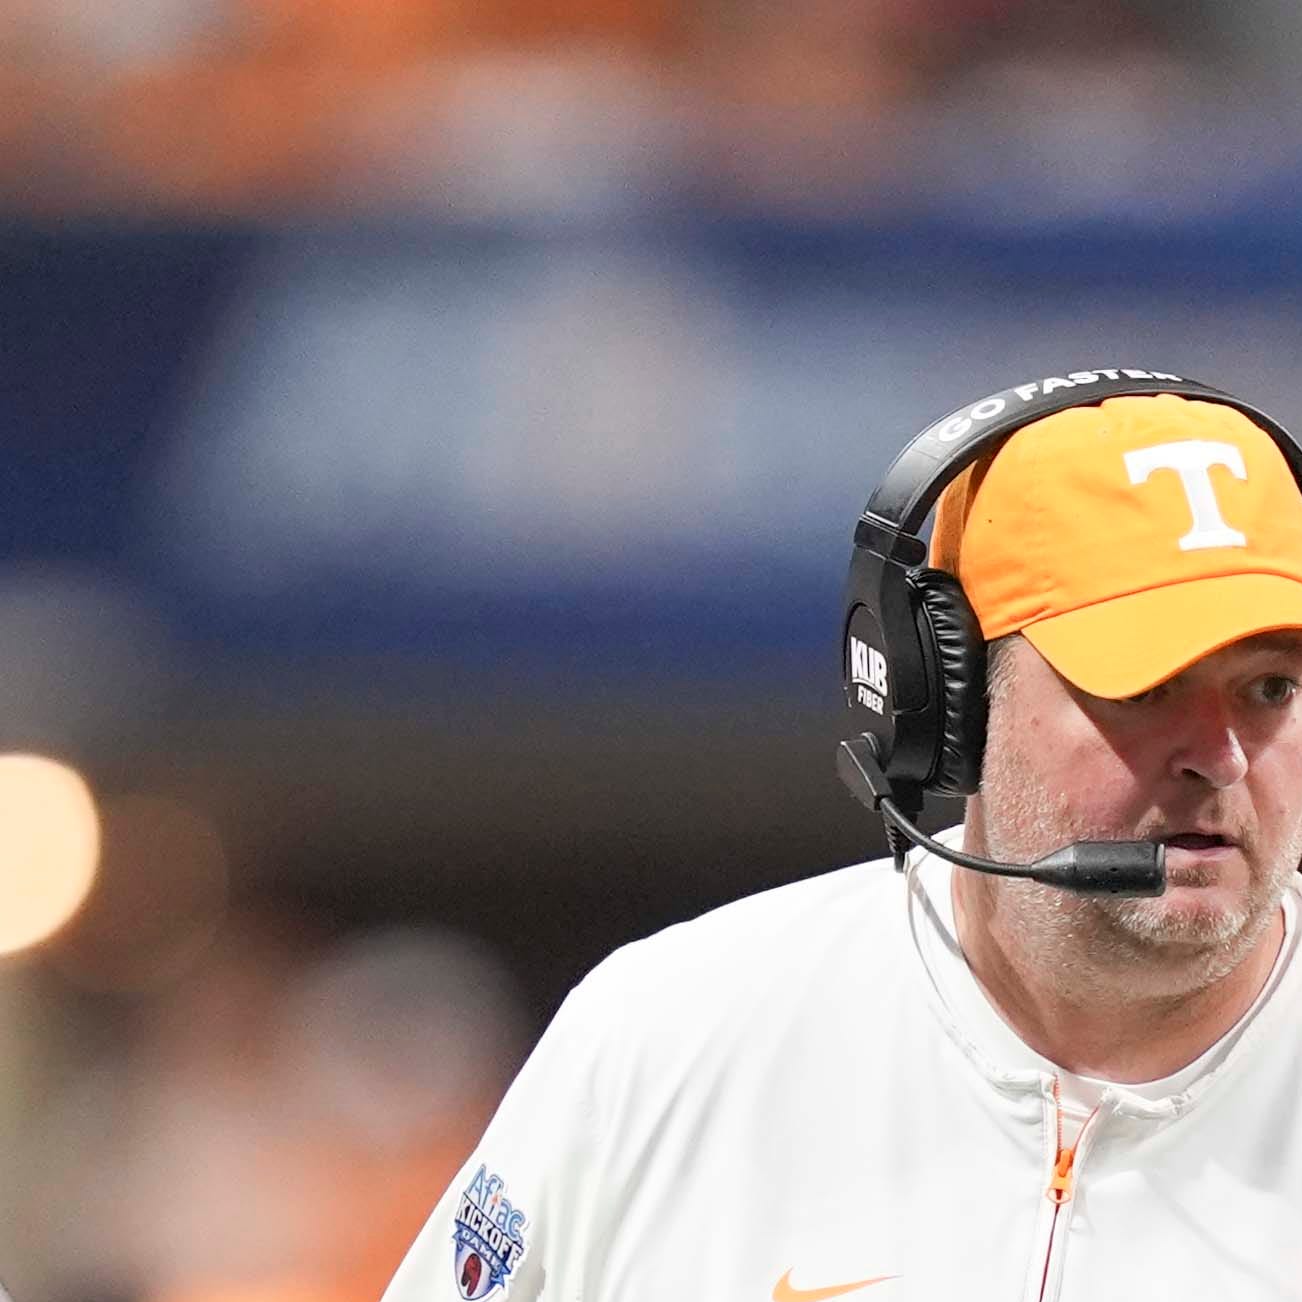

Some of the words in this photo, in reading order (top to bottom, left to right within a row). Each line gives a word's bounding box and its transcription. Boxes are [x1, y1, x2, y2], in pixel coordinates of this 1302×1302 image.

[939, 398, 1006, 442] GO
[1123, 439, 1248, 551] T
[850, 636, 888, 697] KUB
[858, 684, 884, 715] FIBER
[456, 1196, 525, 1270] KICKOFF
